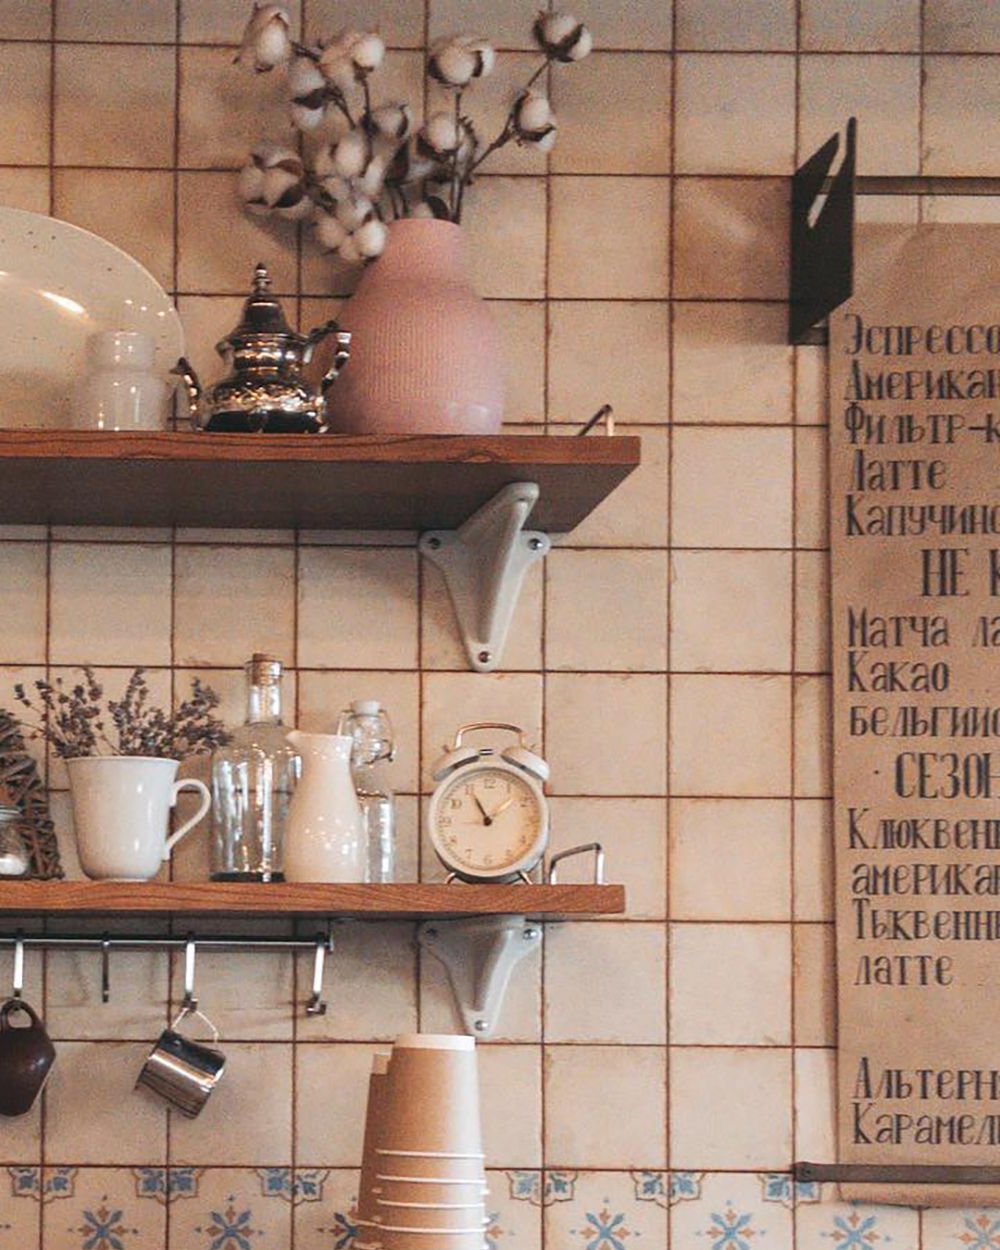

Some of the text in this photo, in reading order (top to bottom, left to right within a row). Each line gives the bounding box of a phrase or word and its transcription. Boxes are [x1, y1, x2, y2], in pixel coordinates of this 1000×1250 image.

[852, 449, 948, 492] Латте
[920, 547, 970, 597] НЕ
[847, 606, 949, 648] Матча
[847, 650, 949, 692] Какао
[853, 955, 953, 987] латте
[852, 1056, 1000, 1100] Альтерн
